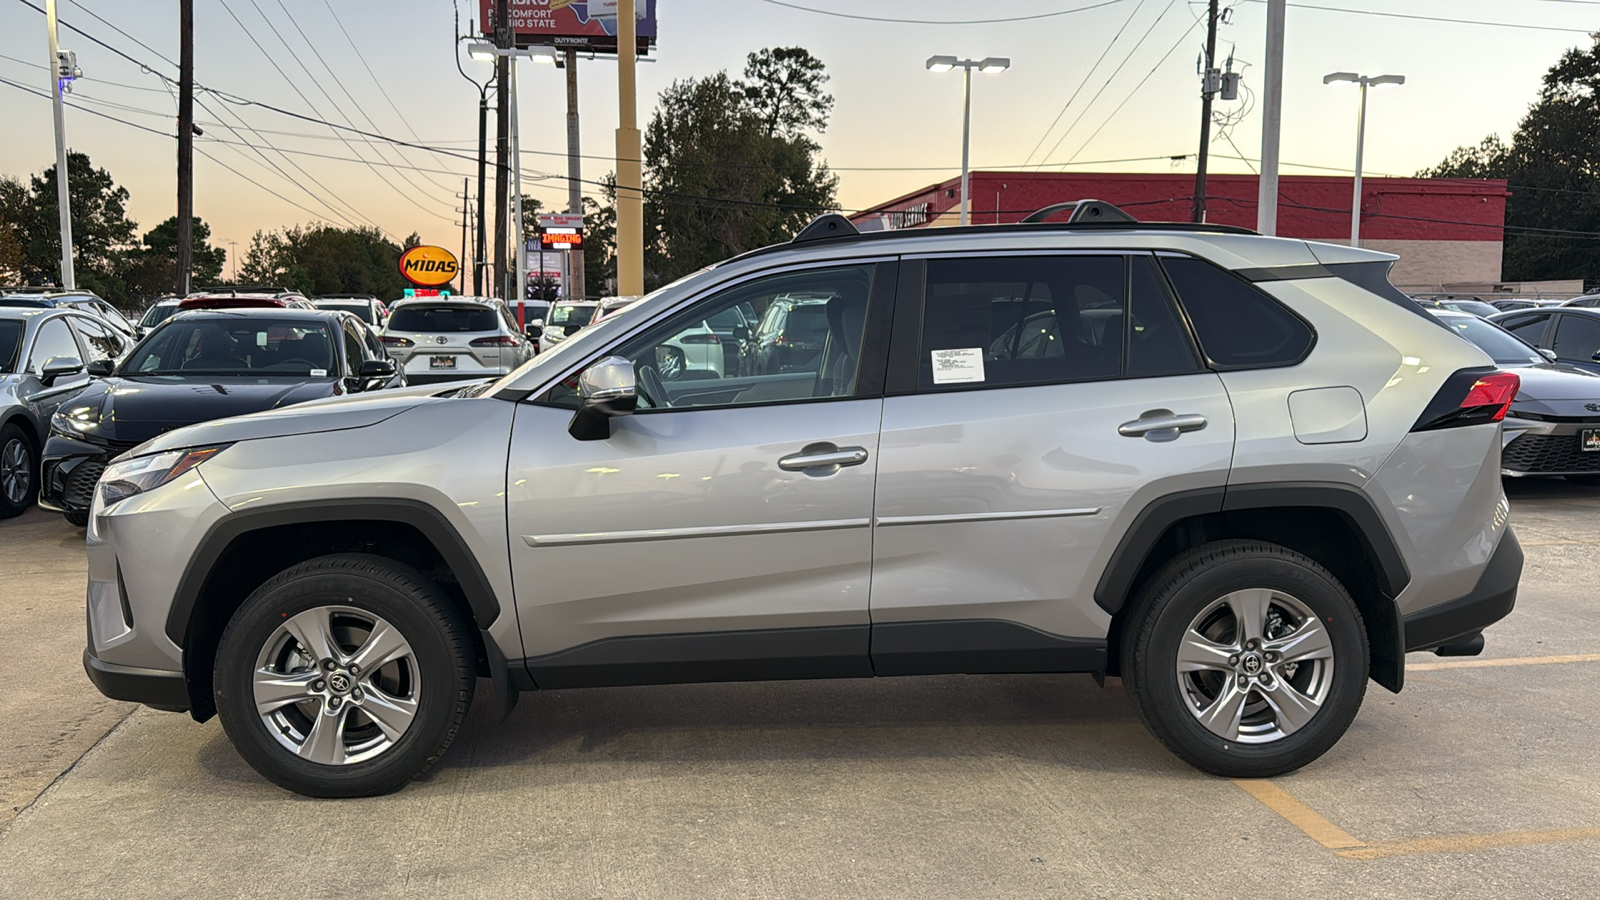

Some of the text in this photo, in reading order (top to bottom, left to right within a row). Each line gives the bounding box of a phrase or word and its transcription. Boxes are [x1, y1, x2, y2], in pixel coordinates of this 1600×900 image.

[527, 20, 556, 28] STATE
[904, 202, 928, 228] SERVICE
[542, 234, 582, 244] IMAGING
[405, 259, 456, 272] MIDAS
